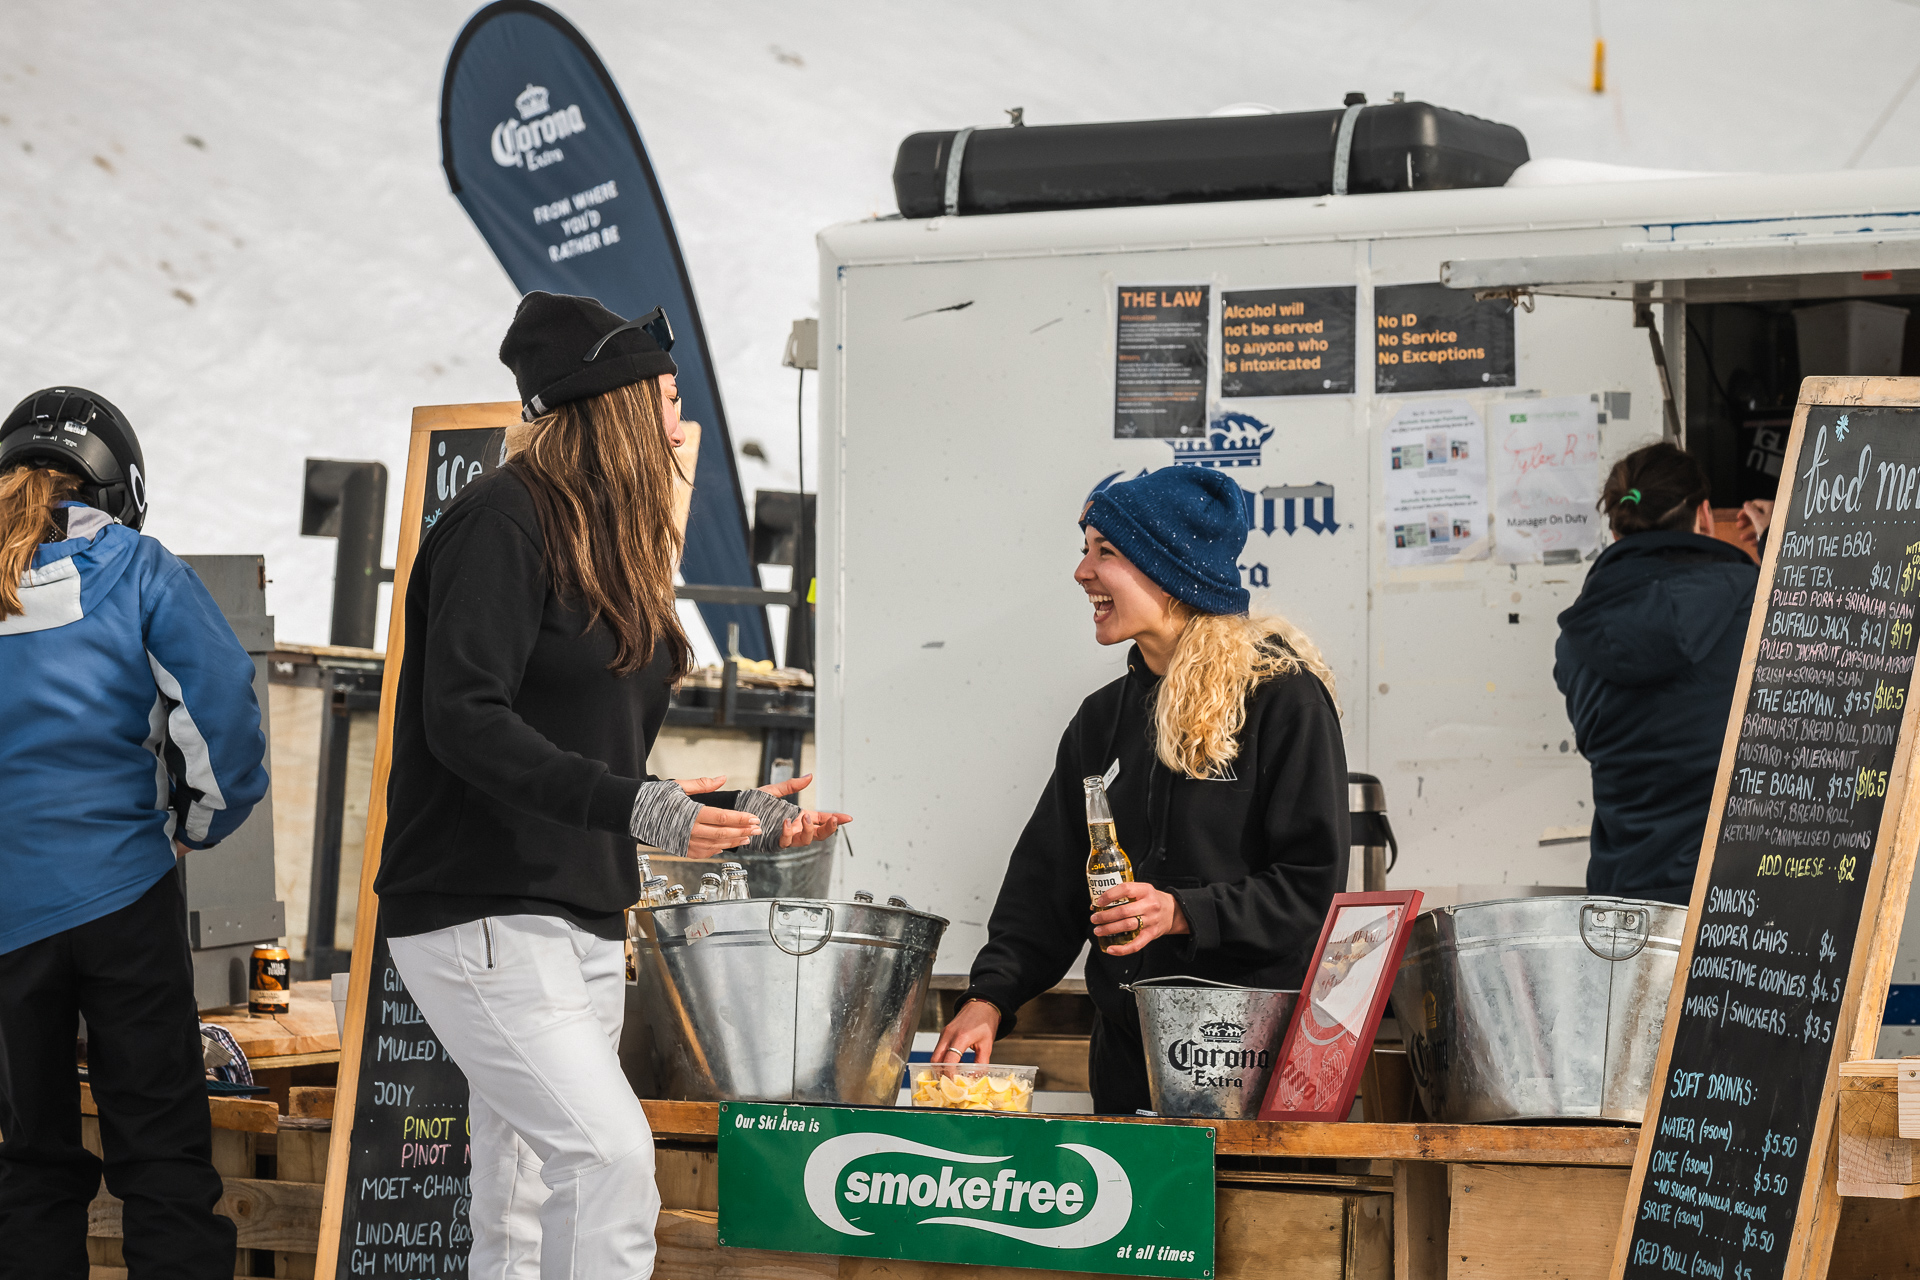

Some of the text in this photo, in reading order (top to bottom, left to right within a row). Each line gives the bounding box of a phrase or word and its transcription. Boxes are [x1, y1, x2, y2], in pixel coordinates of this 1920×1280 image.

[491, 104, 586, 168] Corona
[533, 180, 619, 226] FROM WHERE
[560, 209, 601, 237] YOU'D
[548, 224, 621, 263] RATHER BE
[1121, 291, 1202, 308] THE LAW
[1224, 302, 1304, 320] Alcohol will
[1224, 319, 1324, 337] not be served
[1378, 313, 1418, 328] No ID
[1224, 337, 1329, 357] to anyone who
[1378, 329, 1458, 347] No Service
[1240, 356, 1321, 373] intoxicated
[1378, 346, 1486, 365] No Exceptions
[1803, 424, 1872, 520] food
[1507, 513, 1588, 528] Manager On Duty
[1782, 530, 1877, 559] FROM THE BBQ:
[1782, 565, 1809, 587] THE
[1772, 588, 1807, 607] PULLED
[1809, 590, 1834, 609] PORK
[1844, 592, 1886, 619] SRIRACHA
[1888, 602, 1916, 620] SLAW
[1771, 610, 1819, 638] BUFFALO
[1759, 638, 1793, 662] PULLED
[1840, 648, 1885, 672] CAPSICUM
[1754, 665, 1786, 685] RELISH
[1836, 670, 1864, 688] SLAW
[1757, 688, 1783, 713] THE
[1782, 688, 1836, 717] GERMAN
[1800, 717, 1834, 743] BREAD
[1834, 720, 1859, 746] ROLL,
[1861, 723, 1896, 745] DIJON
[1738, 742, 1783, 767] MUSTARD
[1791, 745, 1860, 771] SAUERKRAUT
[1739, 767, 1767, 795] THE
[1788, 801, 1825, 823] BREAD
[1825, 807, 1855, 828] ROLL,
[1722, 824, 1764, 844] KETCHUP
[1832, 830, 1872, 850] ONIONS
[1088, 876, 1117, 888] orona
[1757, 853, 1857, 884] ADD CHEESE $2
[1708, 885, 1760, 918] SNACKS:
[1699, 923, 1837, 963] PROPER CHIPS $4
[1691, 955, 1757, 988] COOKIETIME
[1810, 969, 1841, 1004] $4.5
[381, 1000, 428, 1026] MULLE
[1803, 1009, 1832, 1044] $3.5
[377, 1035, 437, 1062] MULLED
[1168, 1038, 1269, 1076] Corona
[1194, 1069, 1243, 1088] Extra
[1670, 1068, 1758, 1106] SOFT DRINKS:
[403, 1115, 457, 1140] PINOT
[735, 1113, 820, 1133] Our Ski Area is
[1660, 1115, 1695, 1143] WATER
[1761, 1129, 1798, 1161] $5.50
[401, 1142, 452, 1168] PINOT
[361, 1176, 411, 1200] MOET
[422, 1174, 472, 1199] CHAND
[1652, 1149, 1788, 1197] COKE (330ML) $5.50
[844, 1165, 1085, 1216] smokefree
[1669, 1181, 1698, 1207] SUGAR,
[1698, 1192, 1733, 1216] VANILLA,
[1733, 1200, 1767, 1223] REGULAR
[355, 1221, 443, 1248] LINDAUER
[1641, 1199, 1673, 1223] SRITE
[1742, 1221, 1774, 1253] $5.50
[351, 1248, 468, 1276] GH MUMM NV
[1116, 1244, 1196, 1263] at all times
[1633, 1238, 1660, 1266] RED
[1662, 1244, 1688, 1275] BULL
